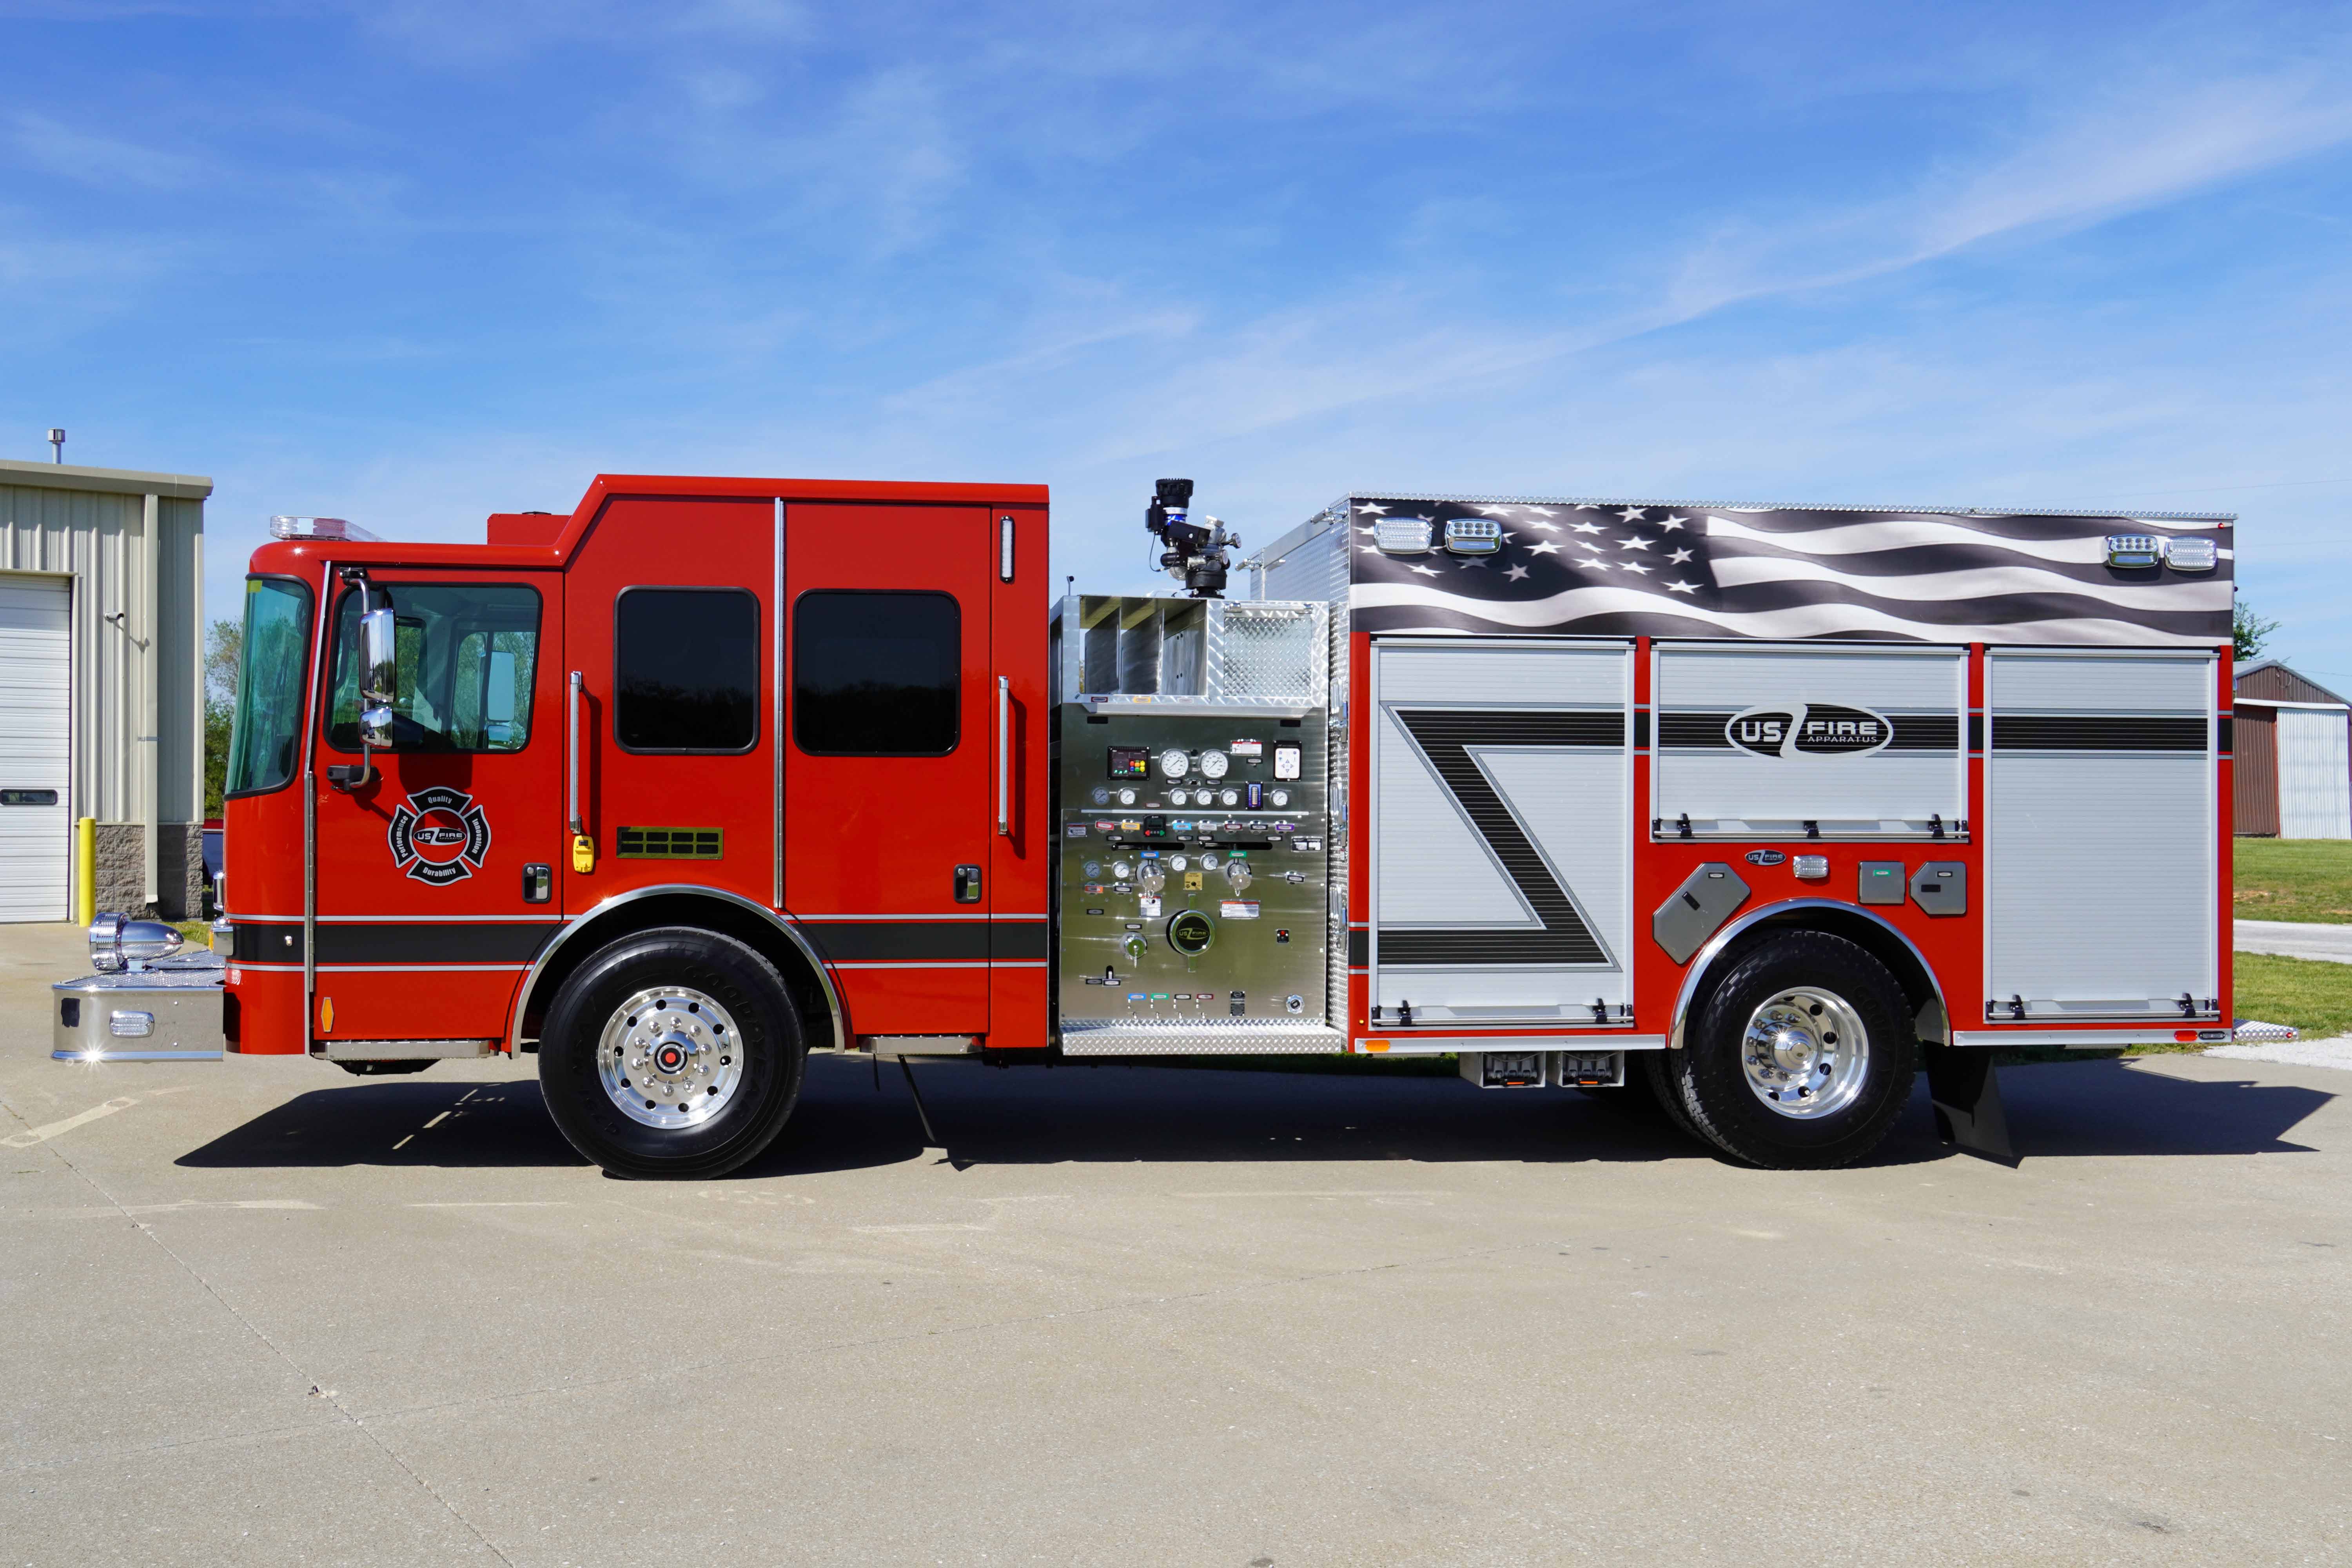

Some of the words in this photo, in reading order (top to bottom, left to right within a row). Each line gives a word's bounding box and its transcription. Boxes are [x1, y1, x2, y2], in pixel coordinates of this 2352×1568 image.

[1741, 721, 1782, 742] US
[1807, 721, 1877, 735] FIRE
[428, 795, 452, 804] Quality
[397, 816, 408, 858] Performance
[472, 818, 482, 854] Innovation
[423, 866, 456, 877] Durability
